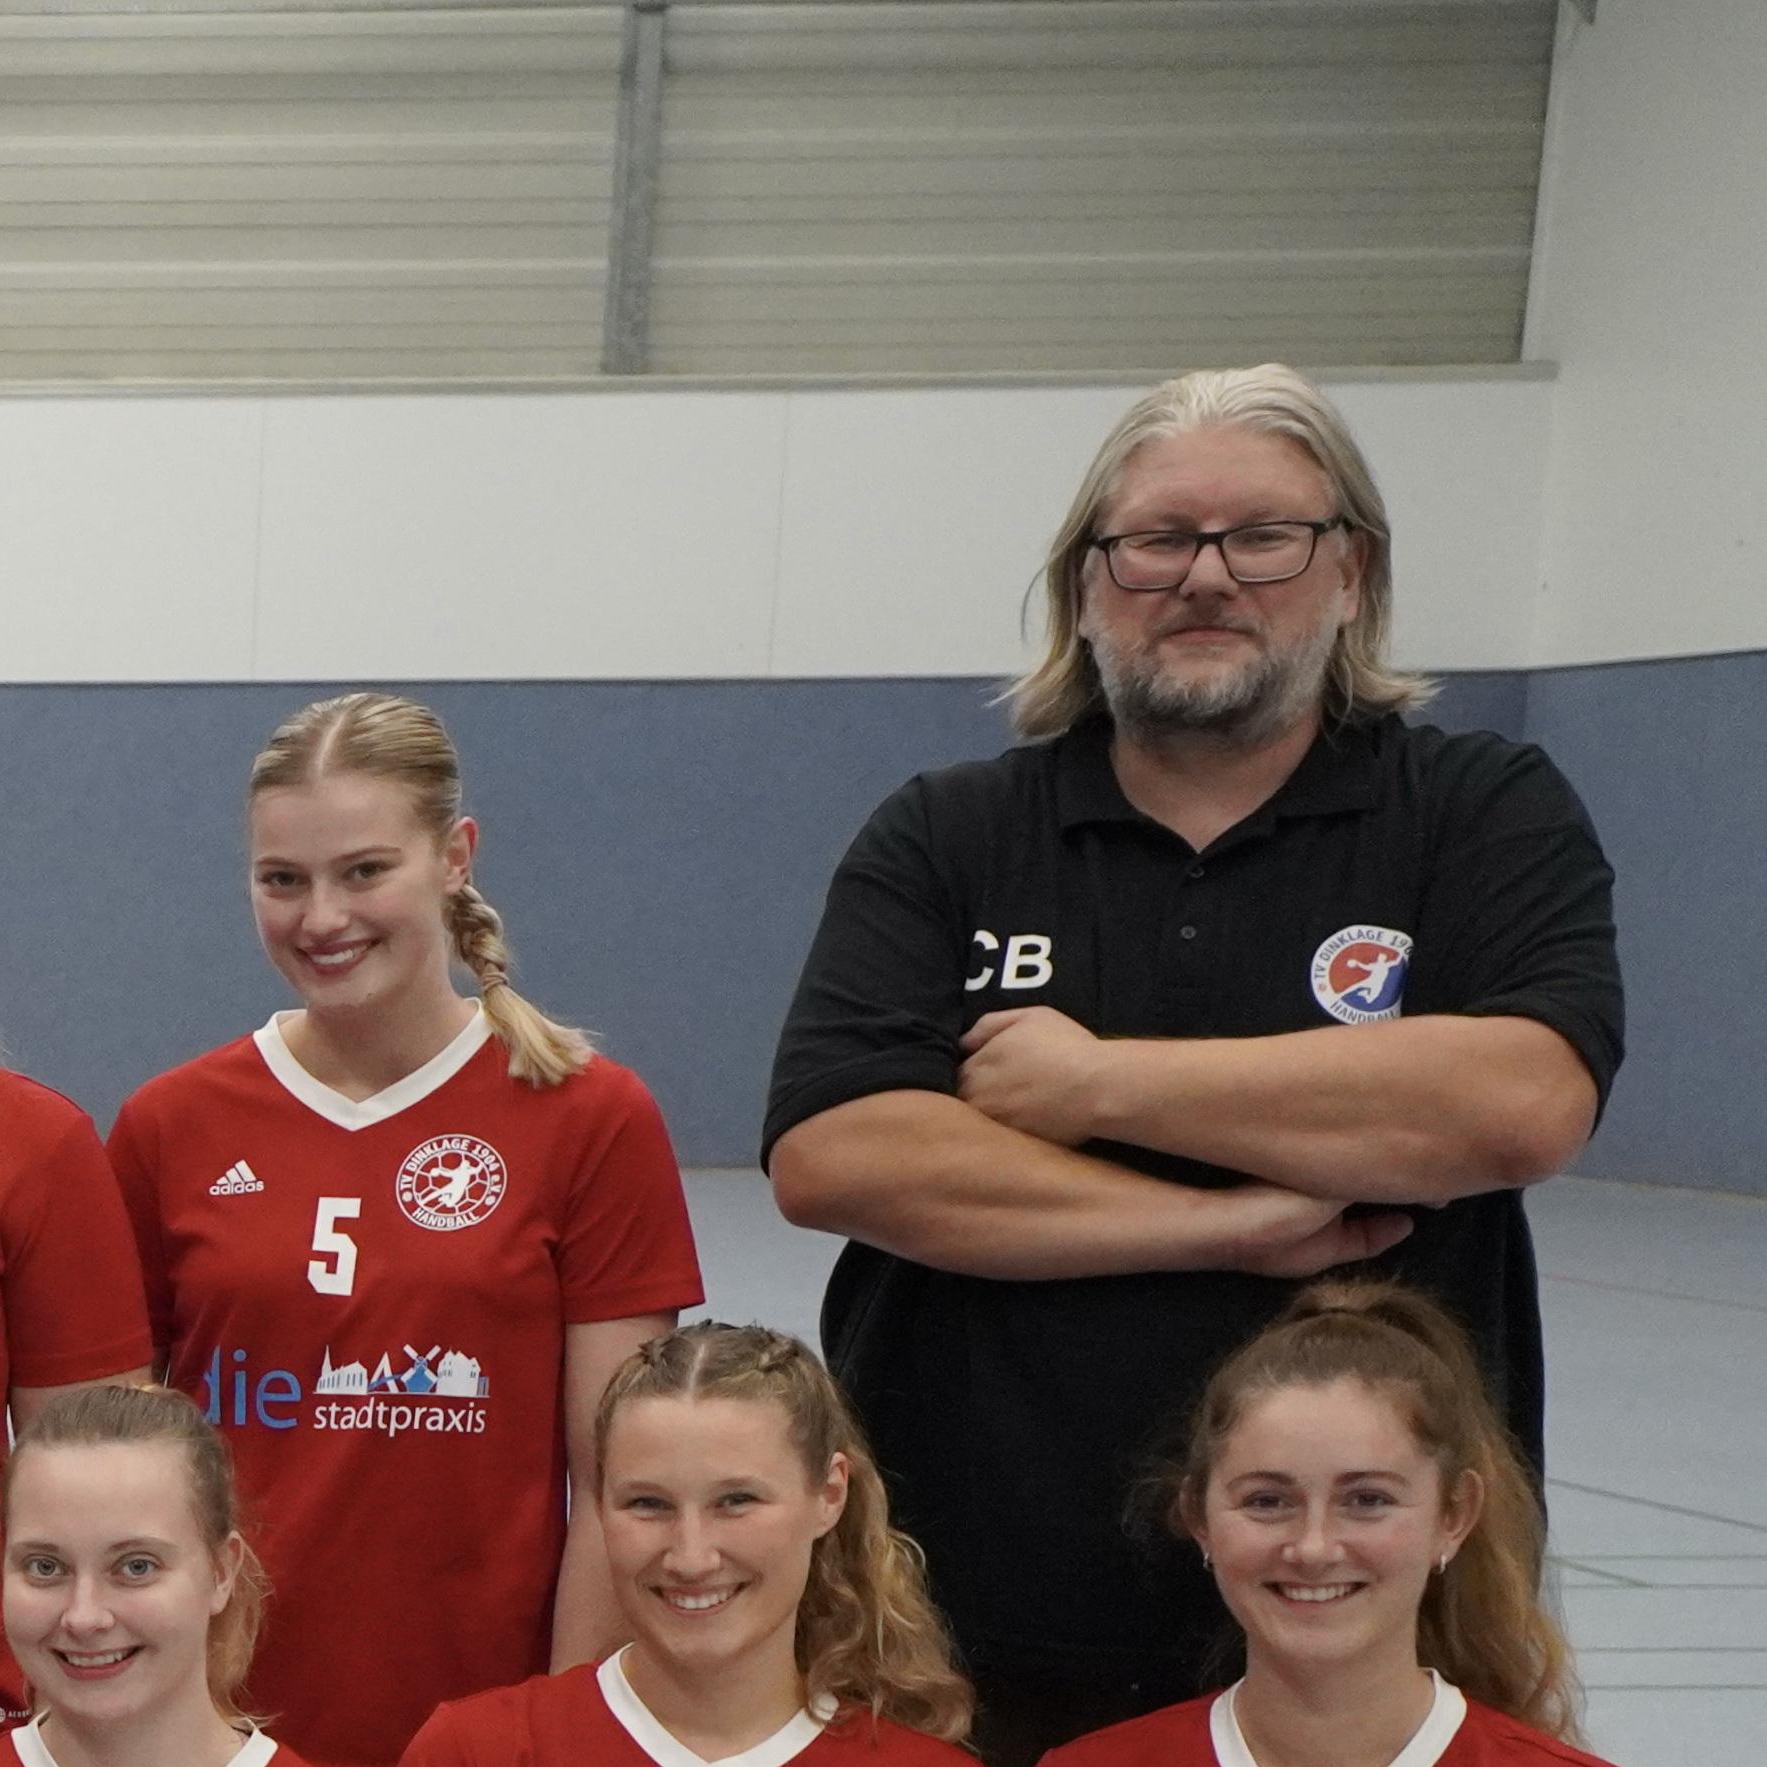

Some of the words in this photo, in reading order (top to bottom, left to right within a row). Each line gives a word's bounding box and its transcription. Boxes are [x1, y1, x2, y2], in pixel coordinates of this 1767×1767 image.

[1324, 928, 1384, 962] DINKLAGE
[406, 1138, 469, 1171] DINKLAGE
[210, 1180, 264, 1196] adidas
[400, 1174, 413, 1190] TV
[412, 1207, 479, 1228] HANDBALL
[308, 1197, 361, 1295] 5
[313, 1396, 486, 1437] stadtpraxis
